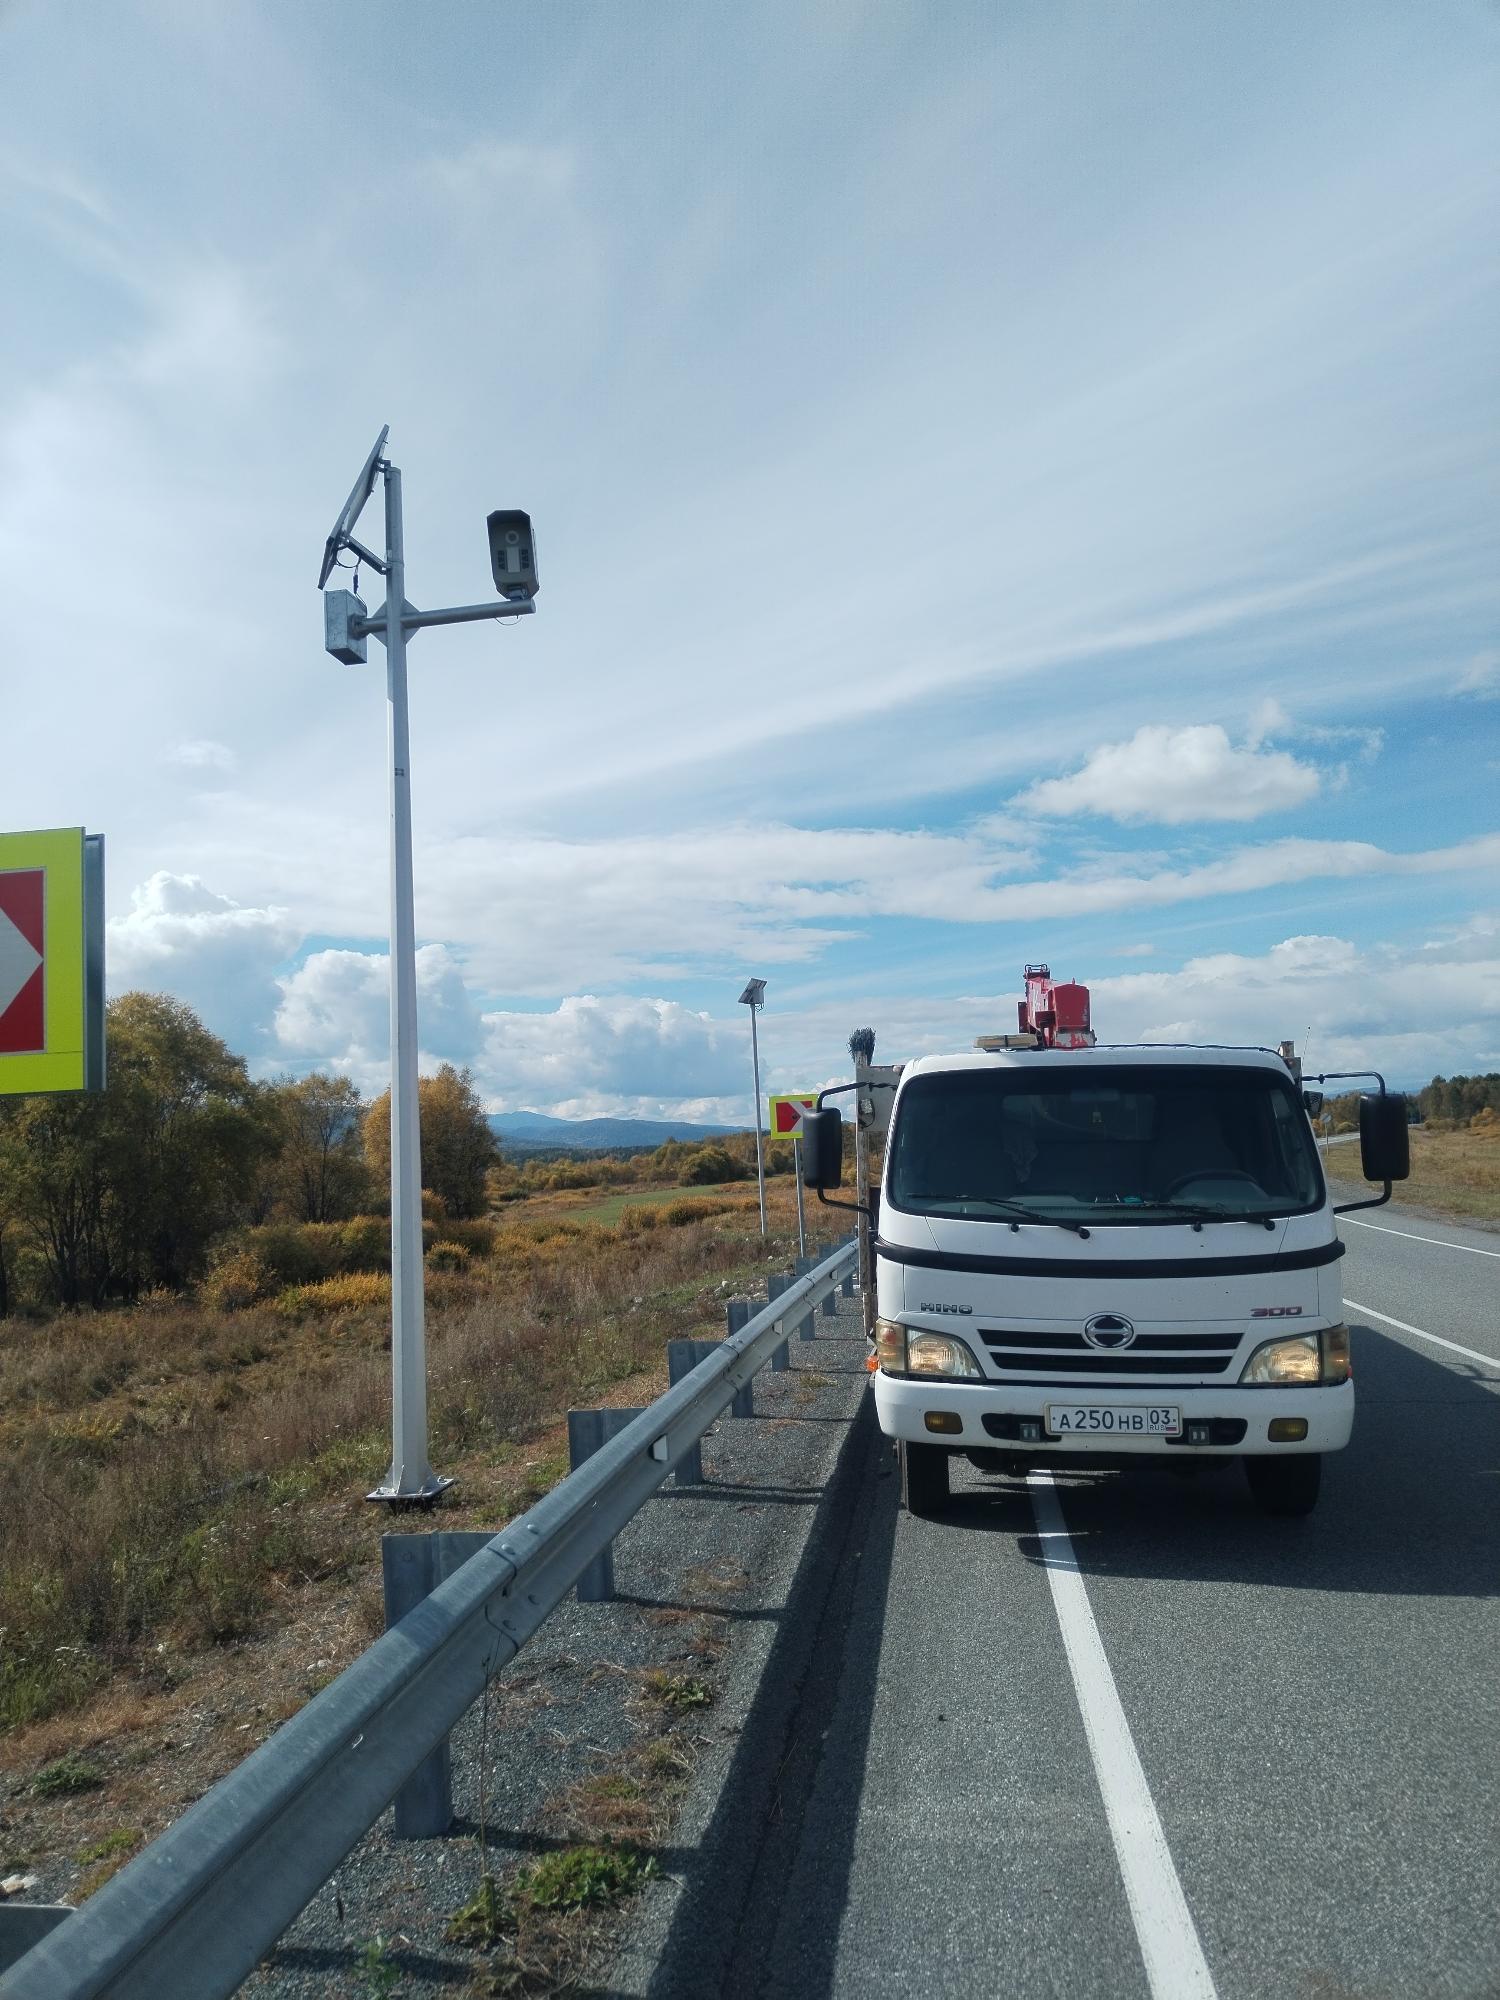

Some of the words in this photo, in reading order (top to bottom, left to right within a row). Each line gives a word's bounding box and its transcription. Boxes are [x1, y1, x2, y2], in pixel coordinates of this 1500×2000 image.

[920, 1302, 972, 1315] HINO
[1250, 1306, 1302, 1317] 300
[1149, 1409, 1171, 1425] 03
